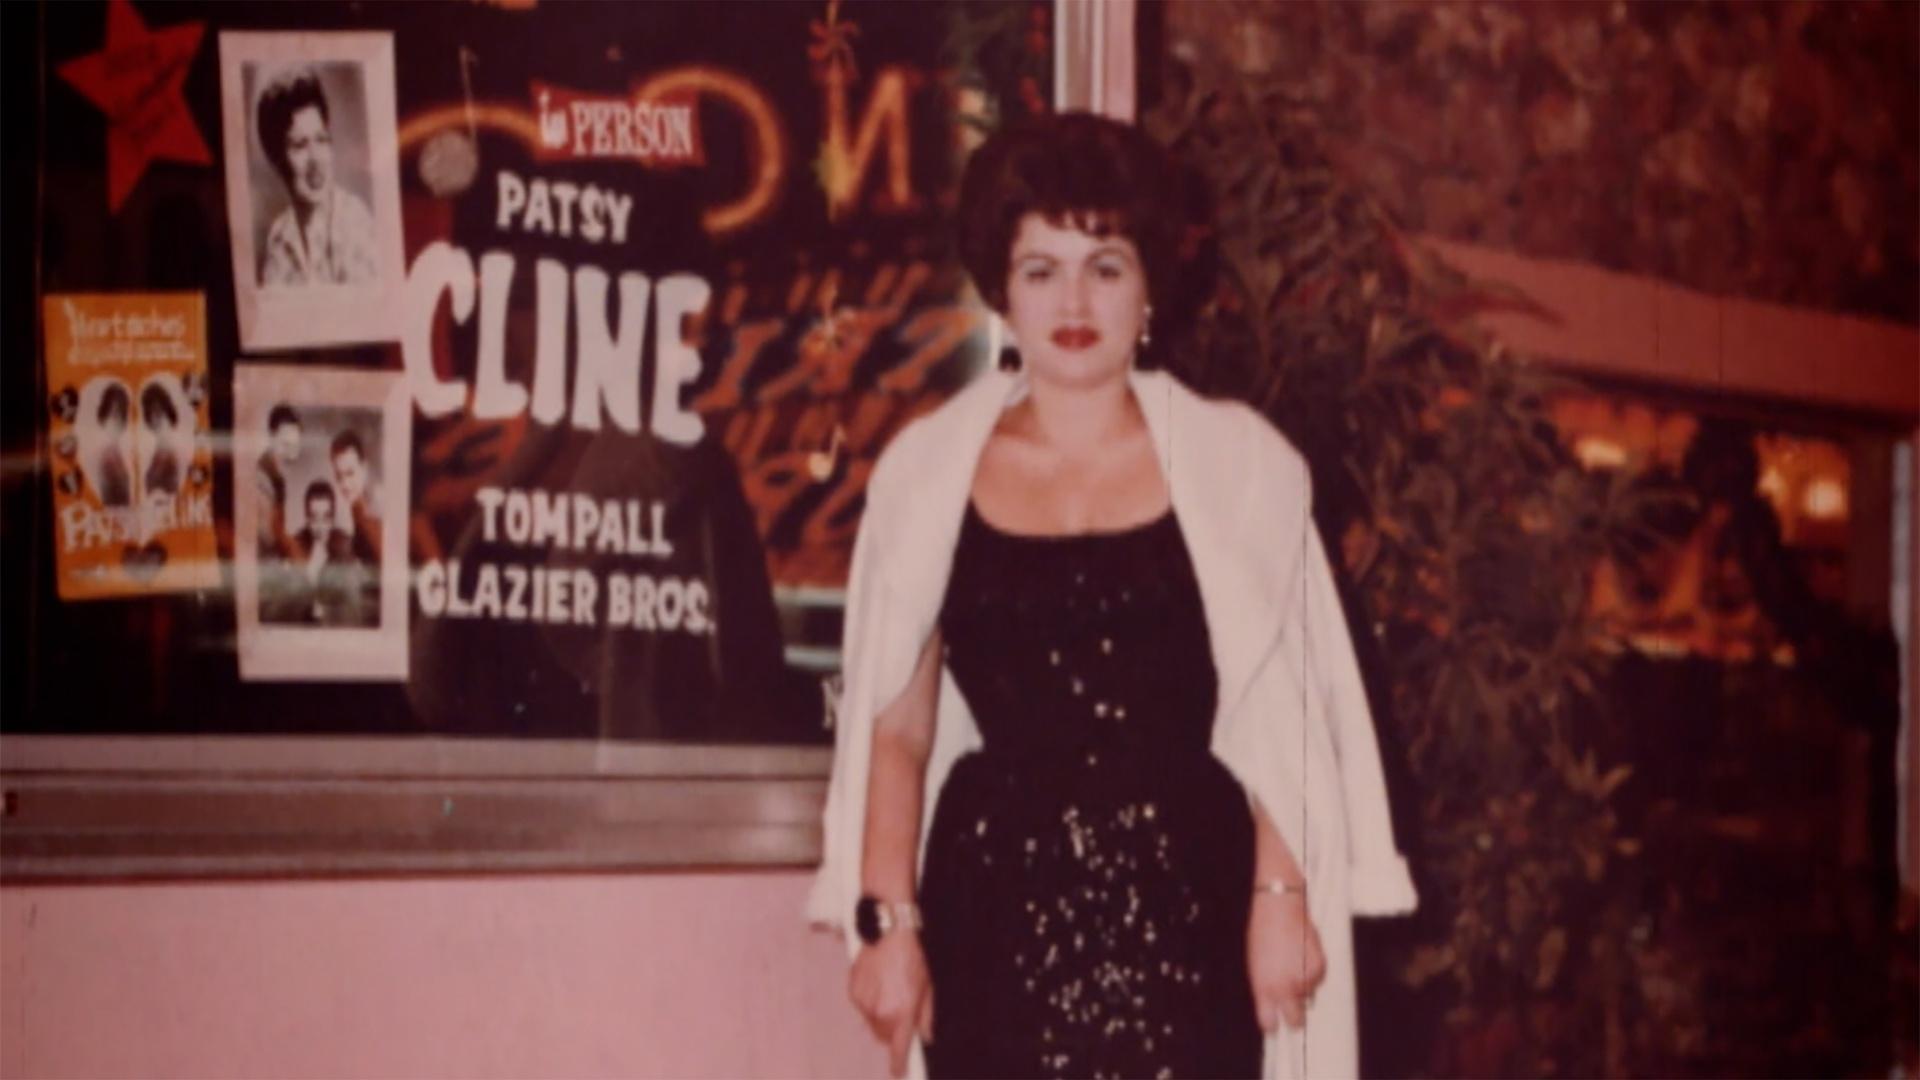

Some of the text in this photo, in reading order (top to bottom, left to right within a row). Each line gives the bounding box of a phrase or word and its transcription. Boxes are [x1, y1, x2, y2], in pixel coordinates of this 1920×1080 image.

[571, 100, 692, 157] PERSON
[496, 171, 633, 243] PATSY
[404, 241, 711, 445] CLINE
[475, 487, 673, 555] TOMPALL
[417, 559, 716, 635] GLAZIER BROS.
